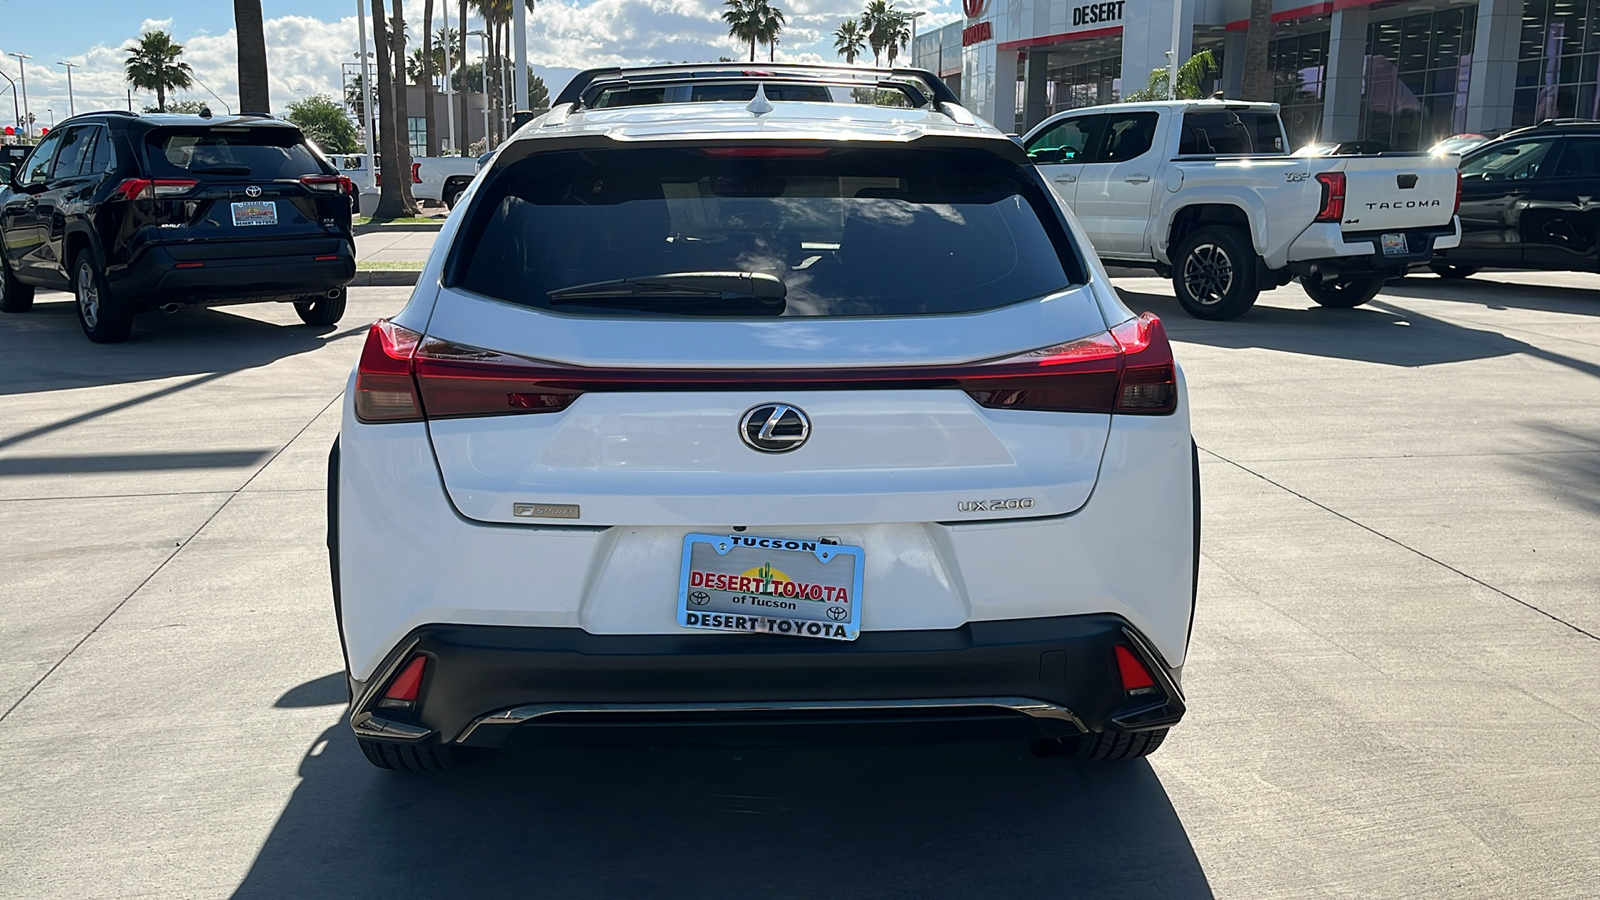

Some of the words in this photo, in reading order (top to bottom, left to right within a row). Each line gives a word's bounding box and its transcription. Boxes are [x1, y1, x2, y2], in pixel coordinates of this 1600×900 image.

[1073, 0, 1125, 26] DESERT
[962, 21, 991, 47] TOYOTA
[1365, 199, 1441, 210] TACOMA
[958, 501, 988, 513] UX
[989, 497, 1035, 512] 200
[731, 536, 817, 552] TUCSON
[690, 571, 764, 594] DESERT
[770, 580, 849, 604] TOYOTA
[732, 596, 745, 605] of
[749, 596, 797, 611] Tucson
[686, 613, 759, 630] DESERT
[766, 619, 848, 638] TOYOTA
